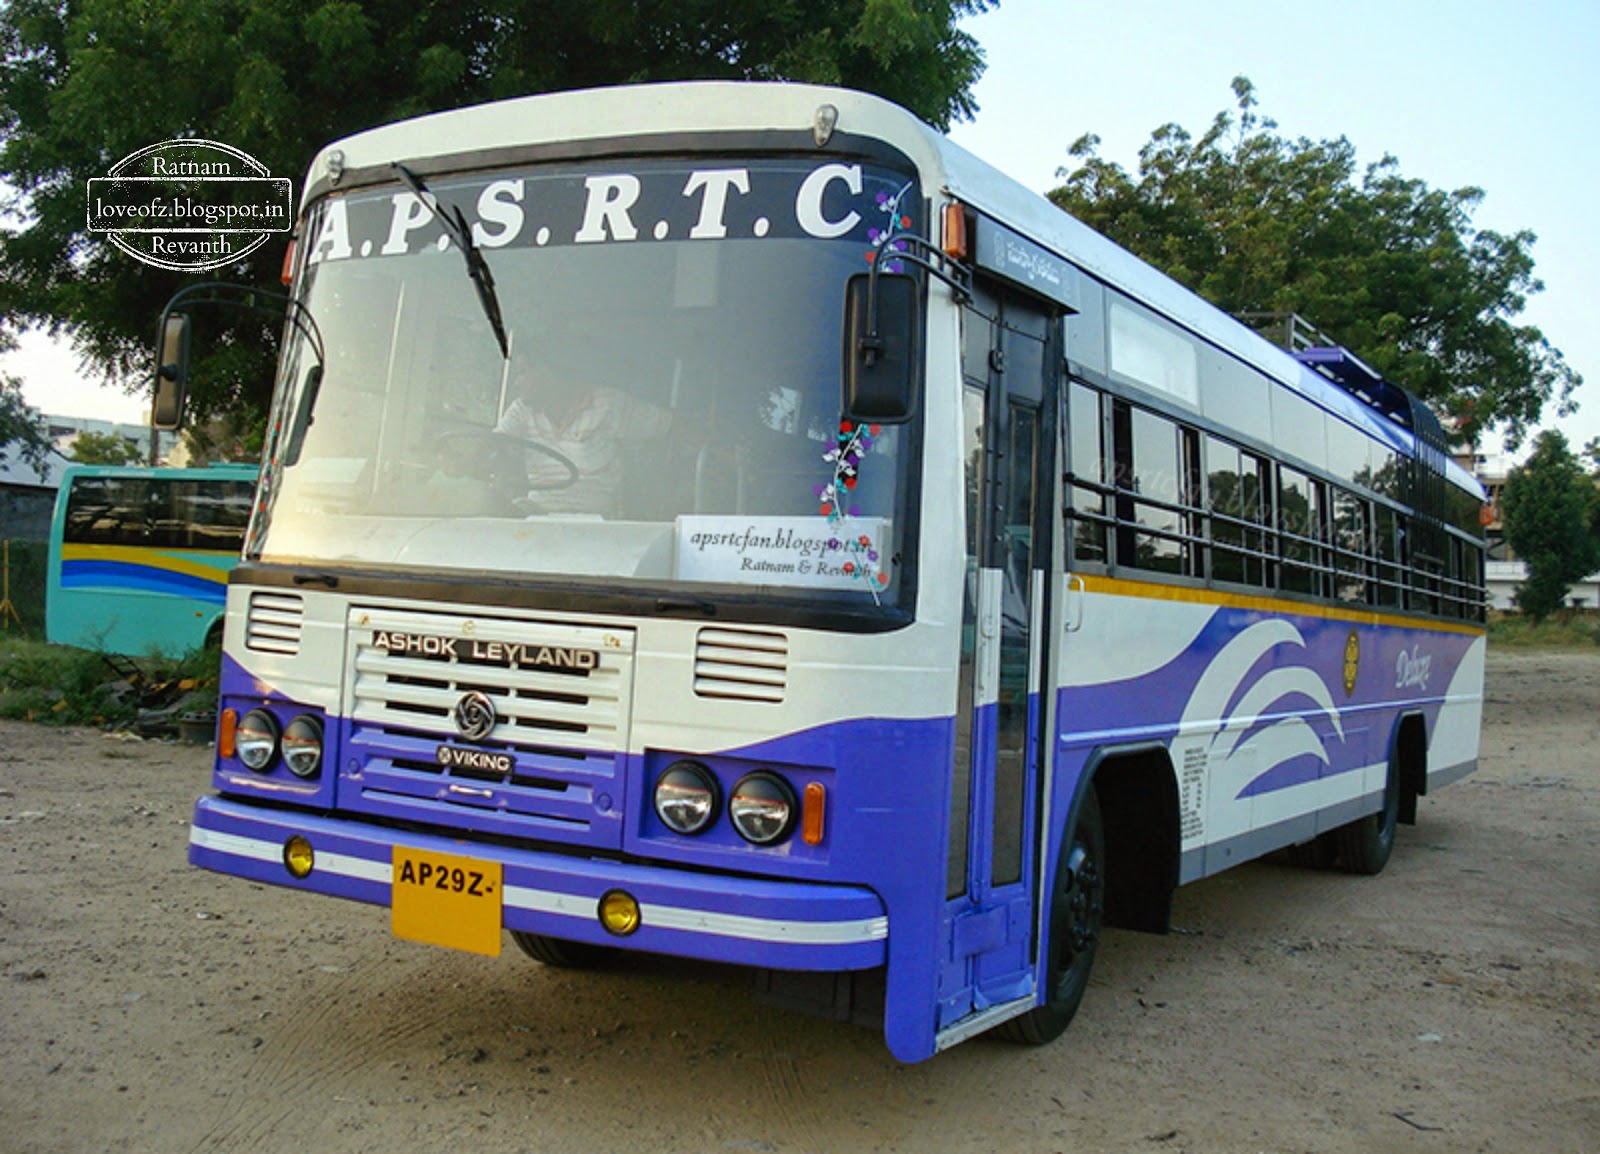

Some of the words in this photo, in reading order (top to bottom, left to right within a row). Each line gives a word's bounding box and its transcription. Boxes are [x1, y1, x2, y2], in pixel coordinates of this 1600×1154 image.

[740, 556, 795, 573] Ratnam
[816, 561, 871, 577] Revh
[374, 631, 457, 656] ASHOK
[472, 640, 596, 669] LEYLAND
[452, 749, 510, 772] VIKING
